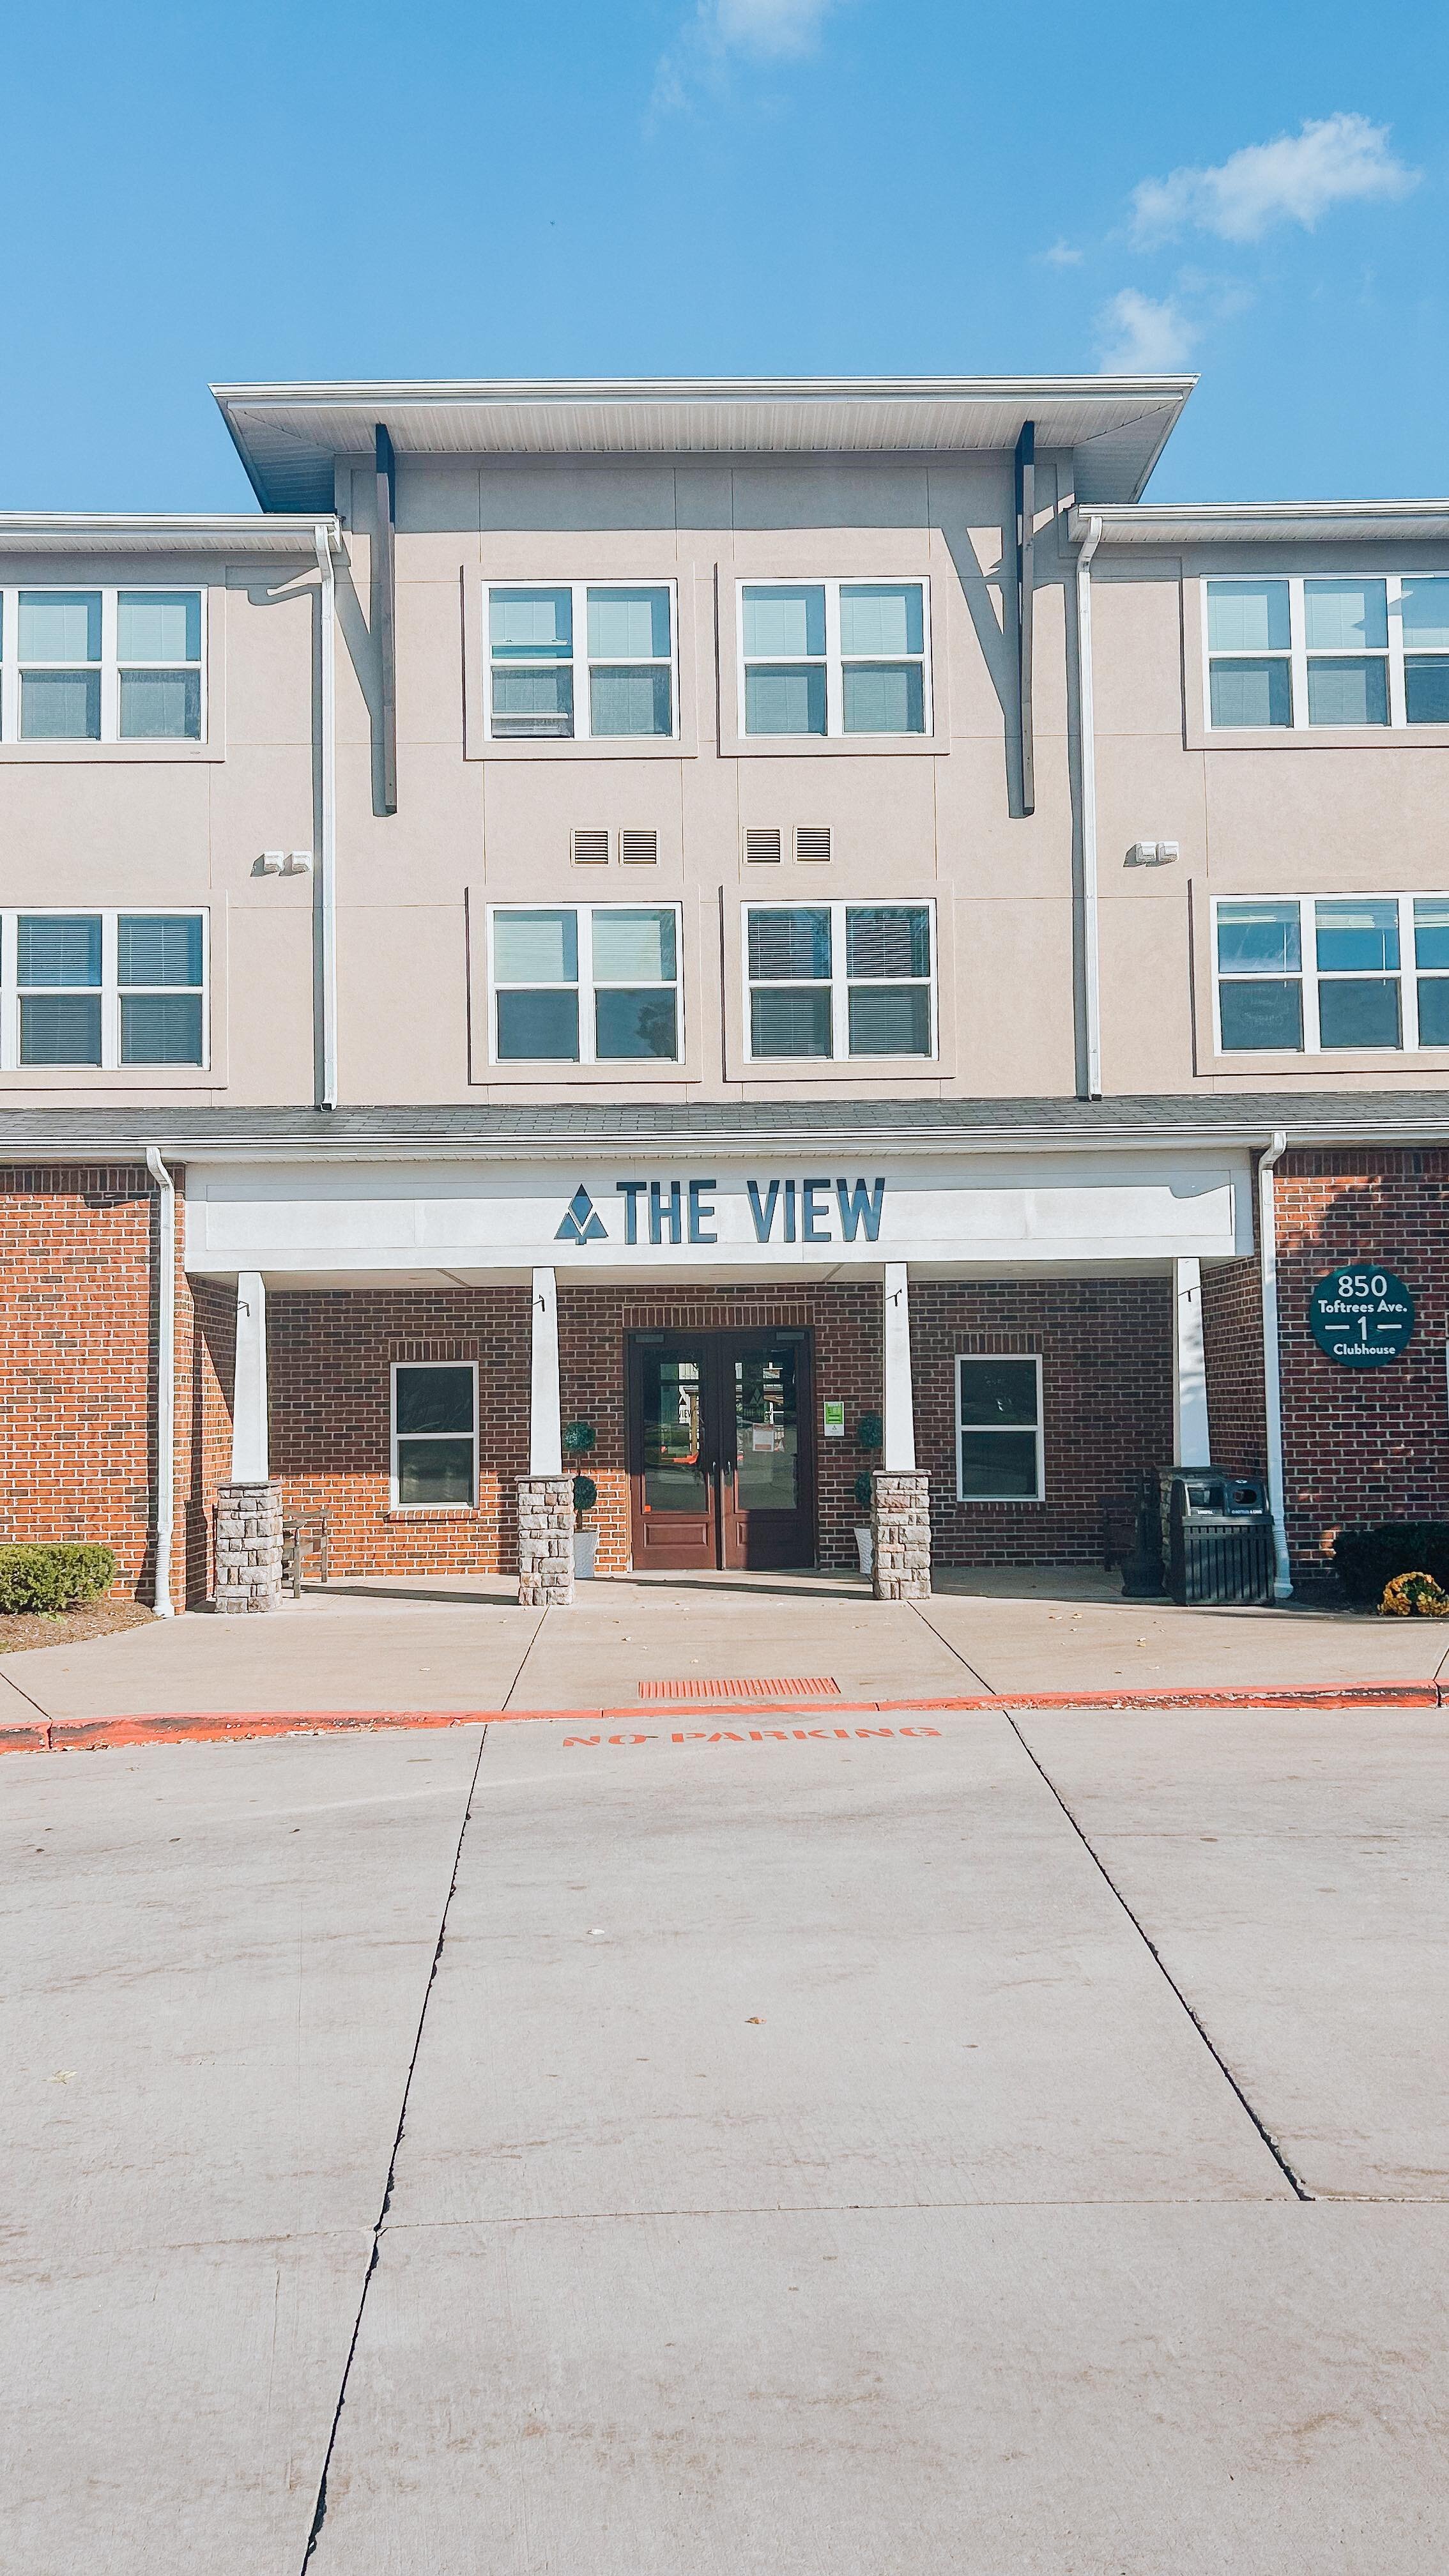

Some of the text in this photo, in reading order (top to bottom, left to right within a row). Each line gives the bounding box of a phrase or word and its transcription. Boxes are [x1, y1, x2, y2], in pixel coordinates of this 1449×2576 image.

[617, 1177, 885, 1245] THE VIEW
[1338, 1275, 1388, 1297] 850
[1317, 1299, 1407, 1313] Toftrees Ave.
[1357, 1316, 1367, 1340] 1
[1333, 1344, 1396, 1355] Clubhouse
[562, 1727, 942, 1747] NO PARKING
